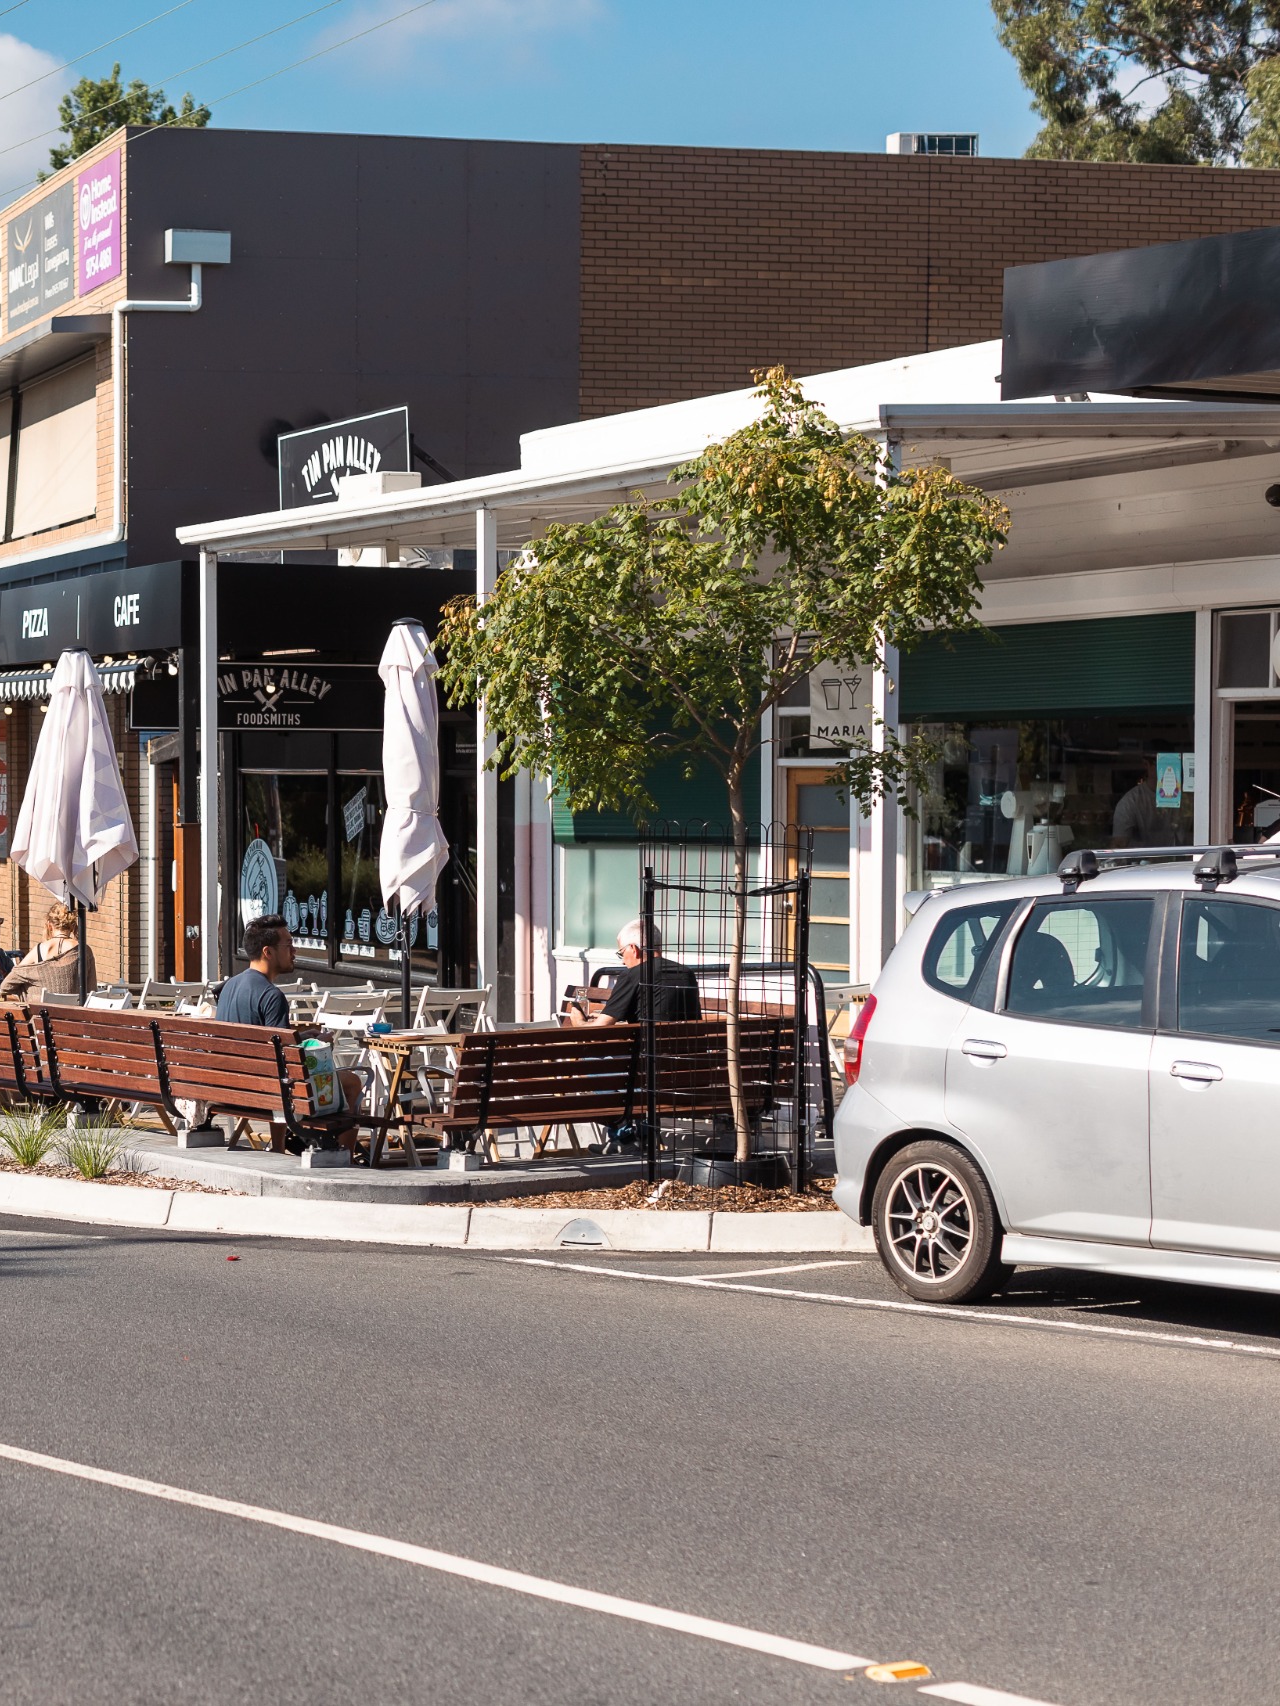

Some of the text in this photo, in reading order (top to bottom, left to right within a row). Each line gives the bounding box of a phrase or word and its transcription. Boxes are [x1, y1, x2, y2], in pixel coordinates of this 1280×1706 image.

[91, 174, 112, 200] Home
[24, 253, 39, 288] Legal
[301, 435, 381, 493] TIN PAN ALLEY
[22, 608, 49, 639] PIZZA
[114, 593, 140, 627] CAFE
[217, 672, 239, 699] IN
[280, 669, 332, 700] ALLEY
[237, 713, 301, 726] FOODSMITHS
[817, 725, 866, 737] MARIA
